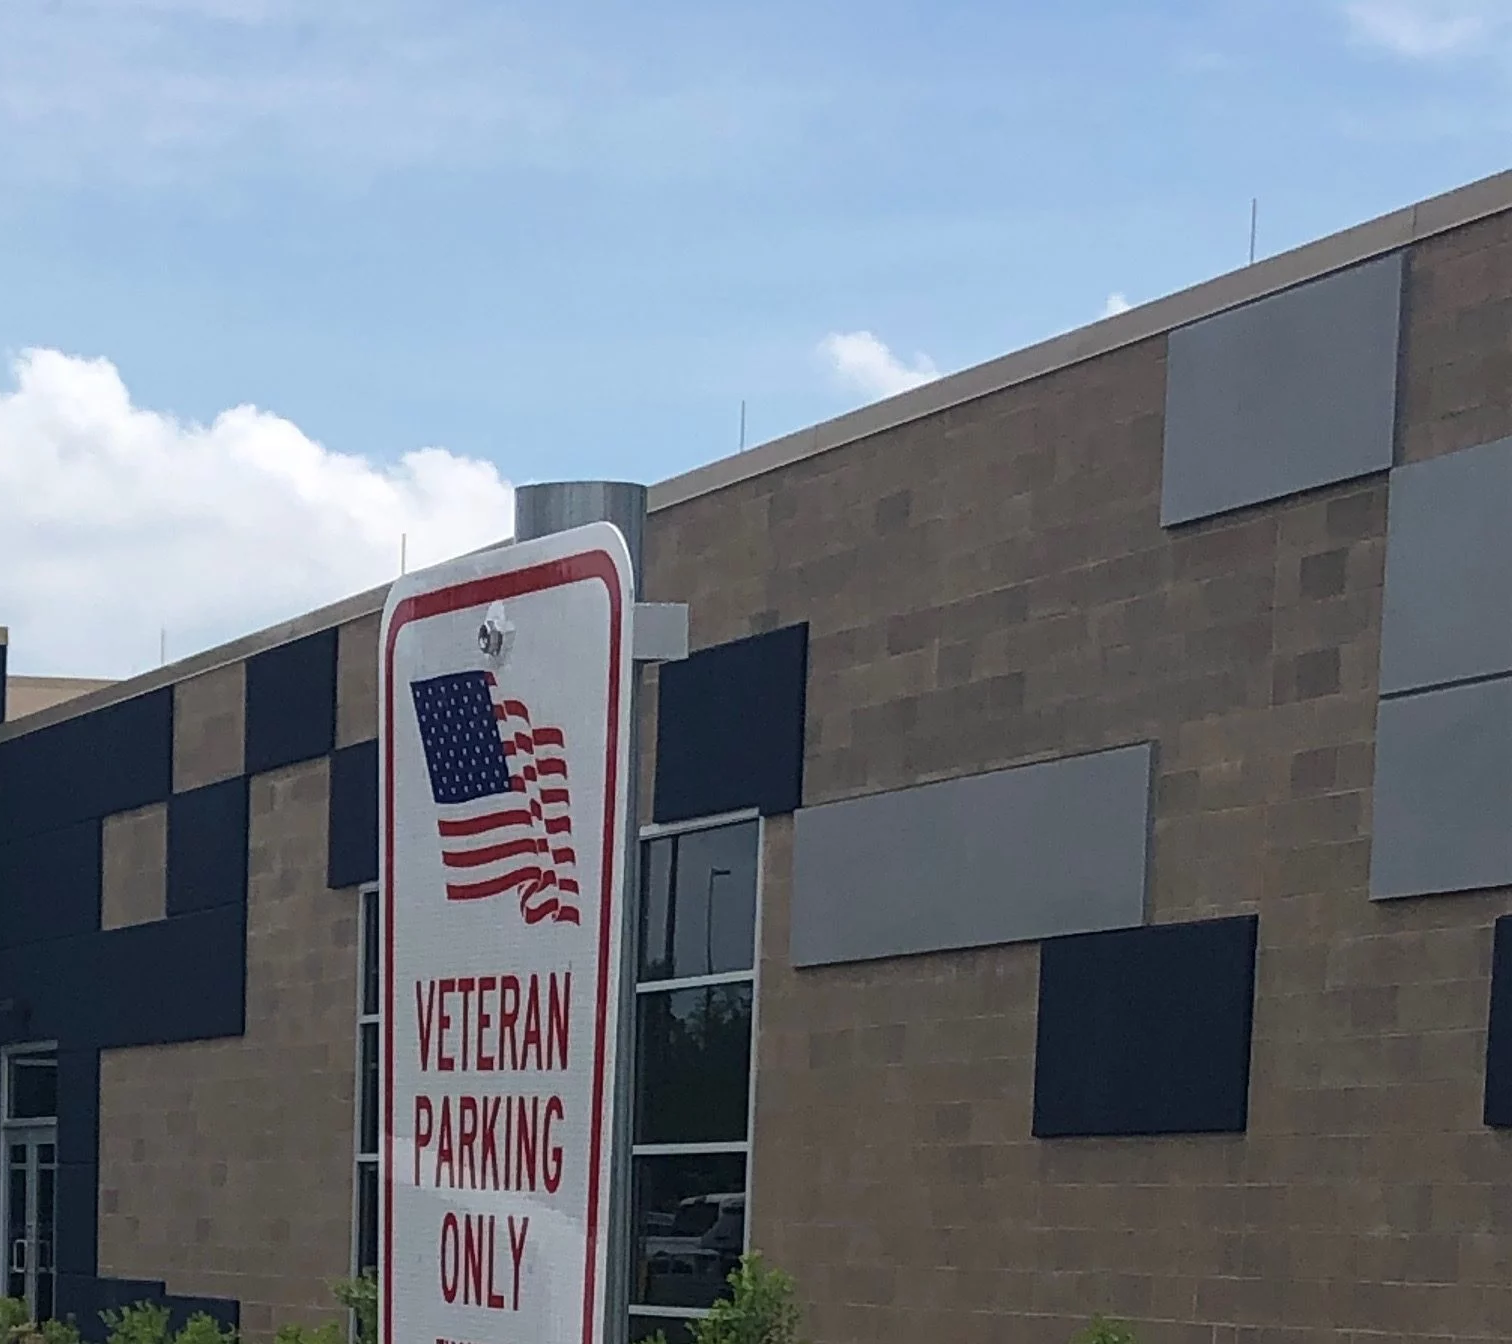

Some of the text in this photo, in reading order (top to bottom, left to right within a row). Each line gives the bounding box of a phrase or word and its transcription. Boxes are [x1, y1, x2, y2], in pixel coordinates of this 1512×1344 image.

[415, 971, 571, 1072] VETERAN
[414, 1095, 565, 1194] PARKING
[440, 1211, 530, 1312] ONLY
